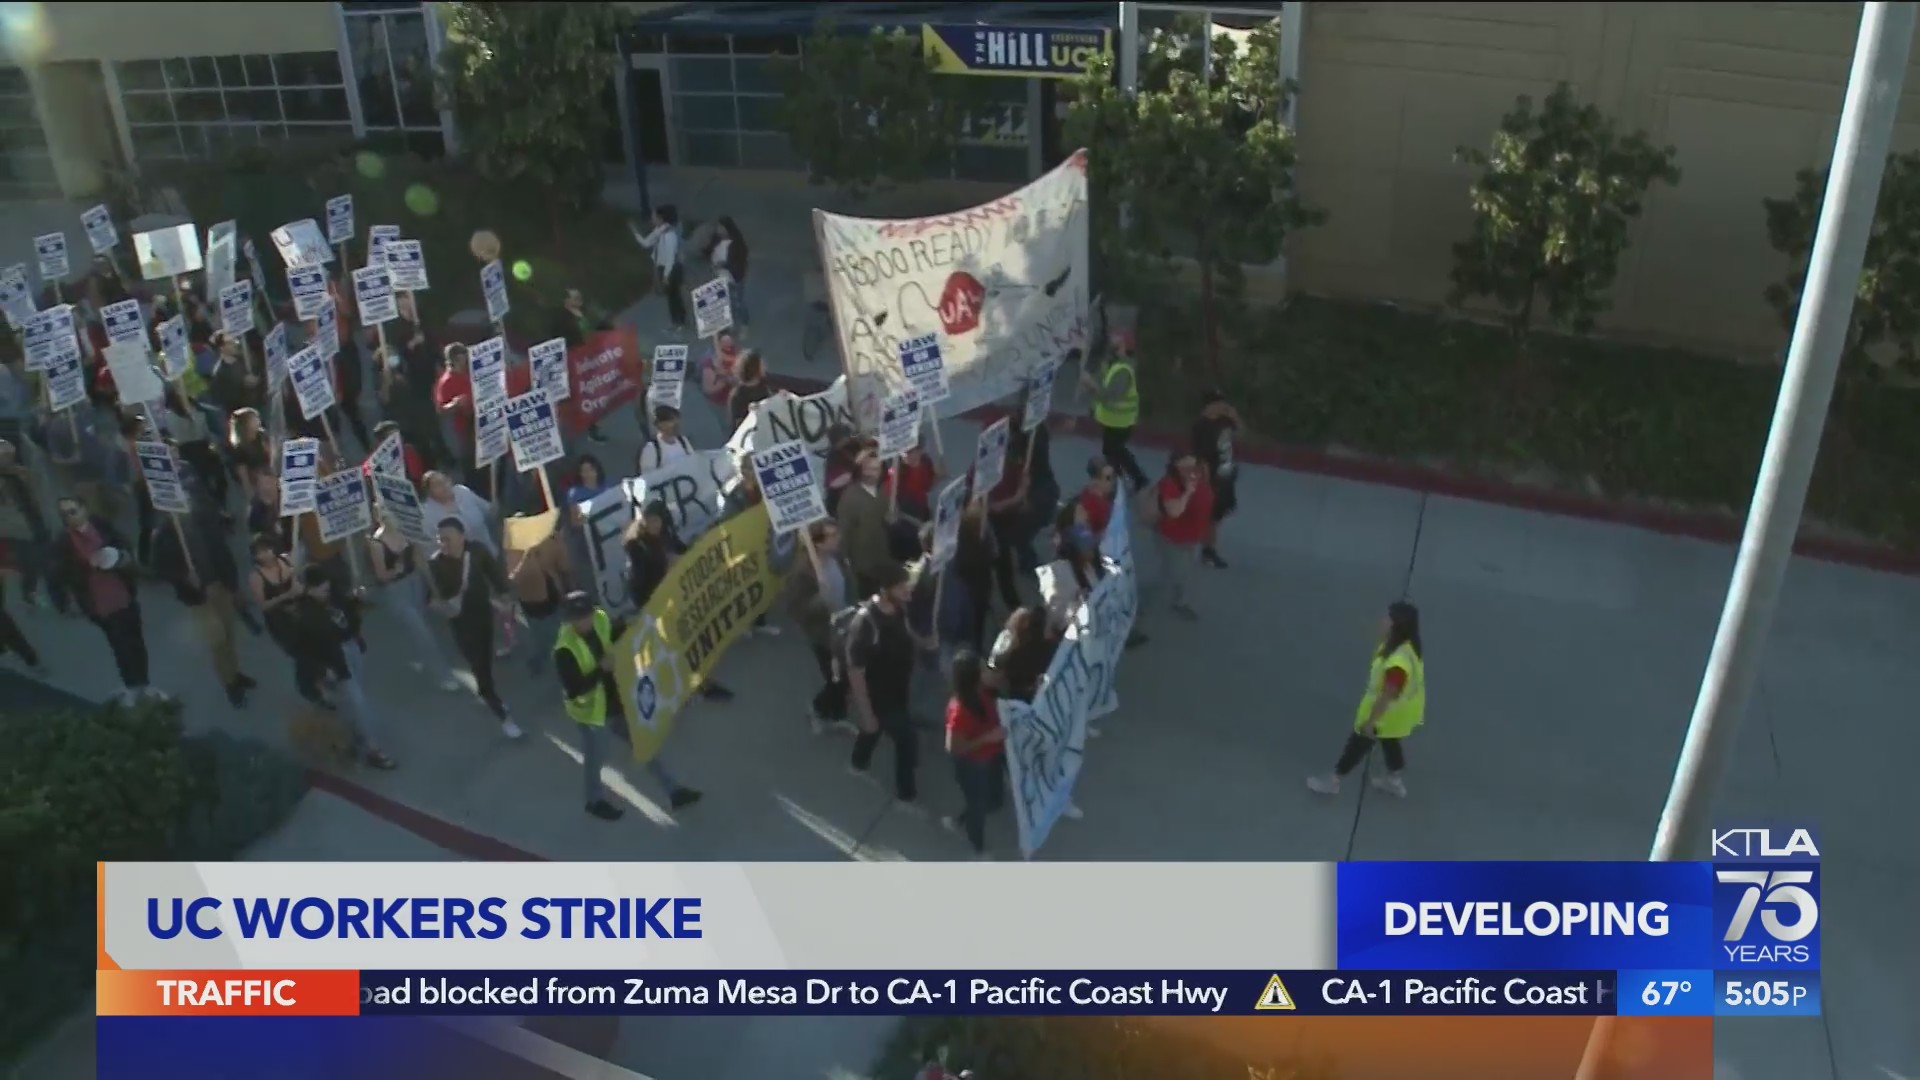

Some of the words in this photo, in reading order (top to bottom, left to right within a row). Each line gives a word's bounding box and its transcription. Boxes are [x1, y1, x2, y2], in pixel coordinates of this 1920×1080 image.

[505, 391, 547, 414] UAW
[755, 443, 802, 468] UAW
[684, 580, 764, 673] UNITED
